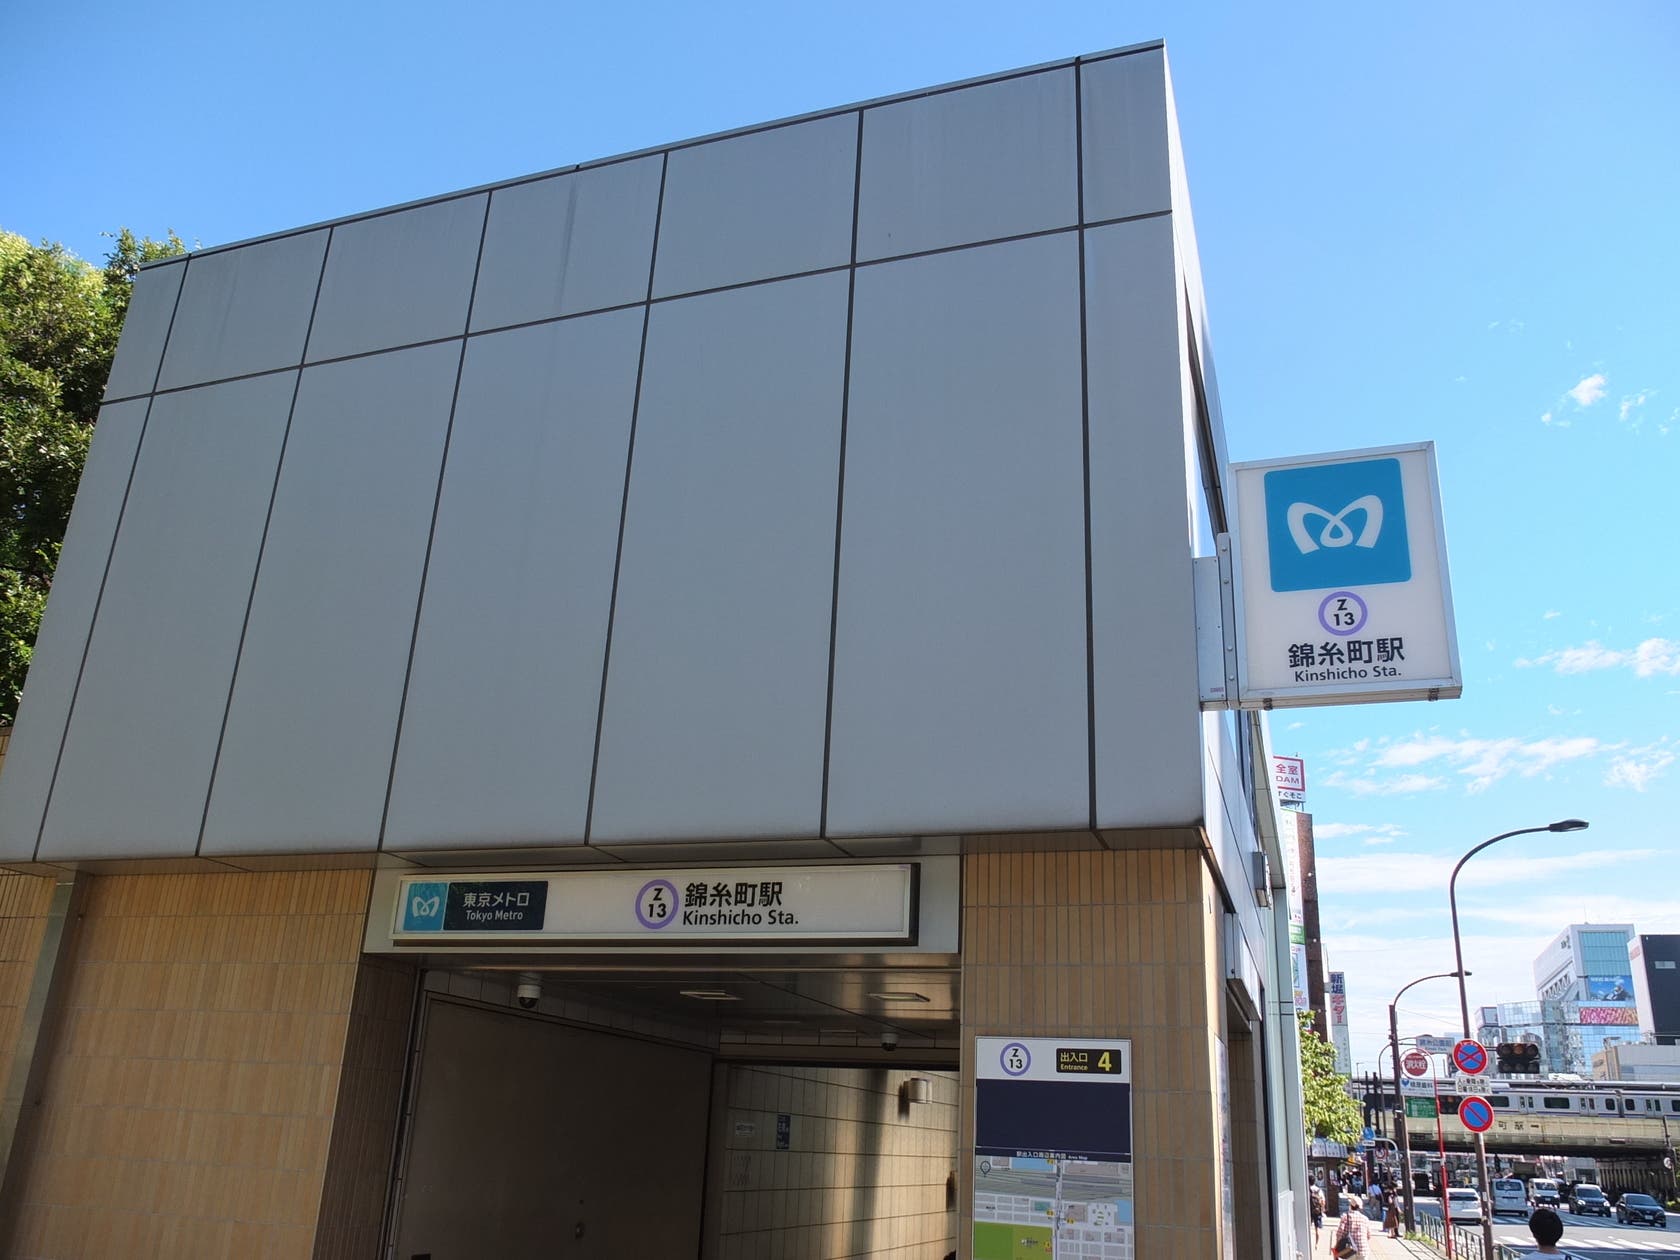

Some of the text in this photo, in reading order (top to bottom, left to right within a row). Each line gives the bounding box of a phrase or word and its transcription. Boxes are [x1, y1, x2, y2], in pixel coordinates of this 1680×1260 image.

[1337, 598, 1348, 611] Z
[1333, 612, 1355, 627] 13
[1288, 637, 1405, 668] 錦糸町駅
[1295, 665, 1402, 682] Kinshicho Sta.
[1276, 775, 1300, 785] DAM
[463, 891, 530, 909] 東京メトロ
[652, 888, 663, 901] Z
[685, 882, 783, 908] 錦糸町駅
[466, 909, 523, 922] Tokyo Metro
[648, 902, 668, 919] 13
[683, 909, 800, 926] Kinshicho Sta.
[1012, 1048, 1019, 1058] Z
[1060, 1052, 1088, 1062] 出入口
[1009, 1058, 1023, 1069] 13
[1060, 1063, 1088, 1071] Entrance
[1097, 1051, 1112, 1072] 4
